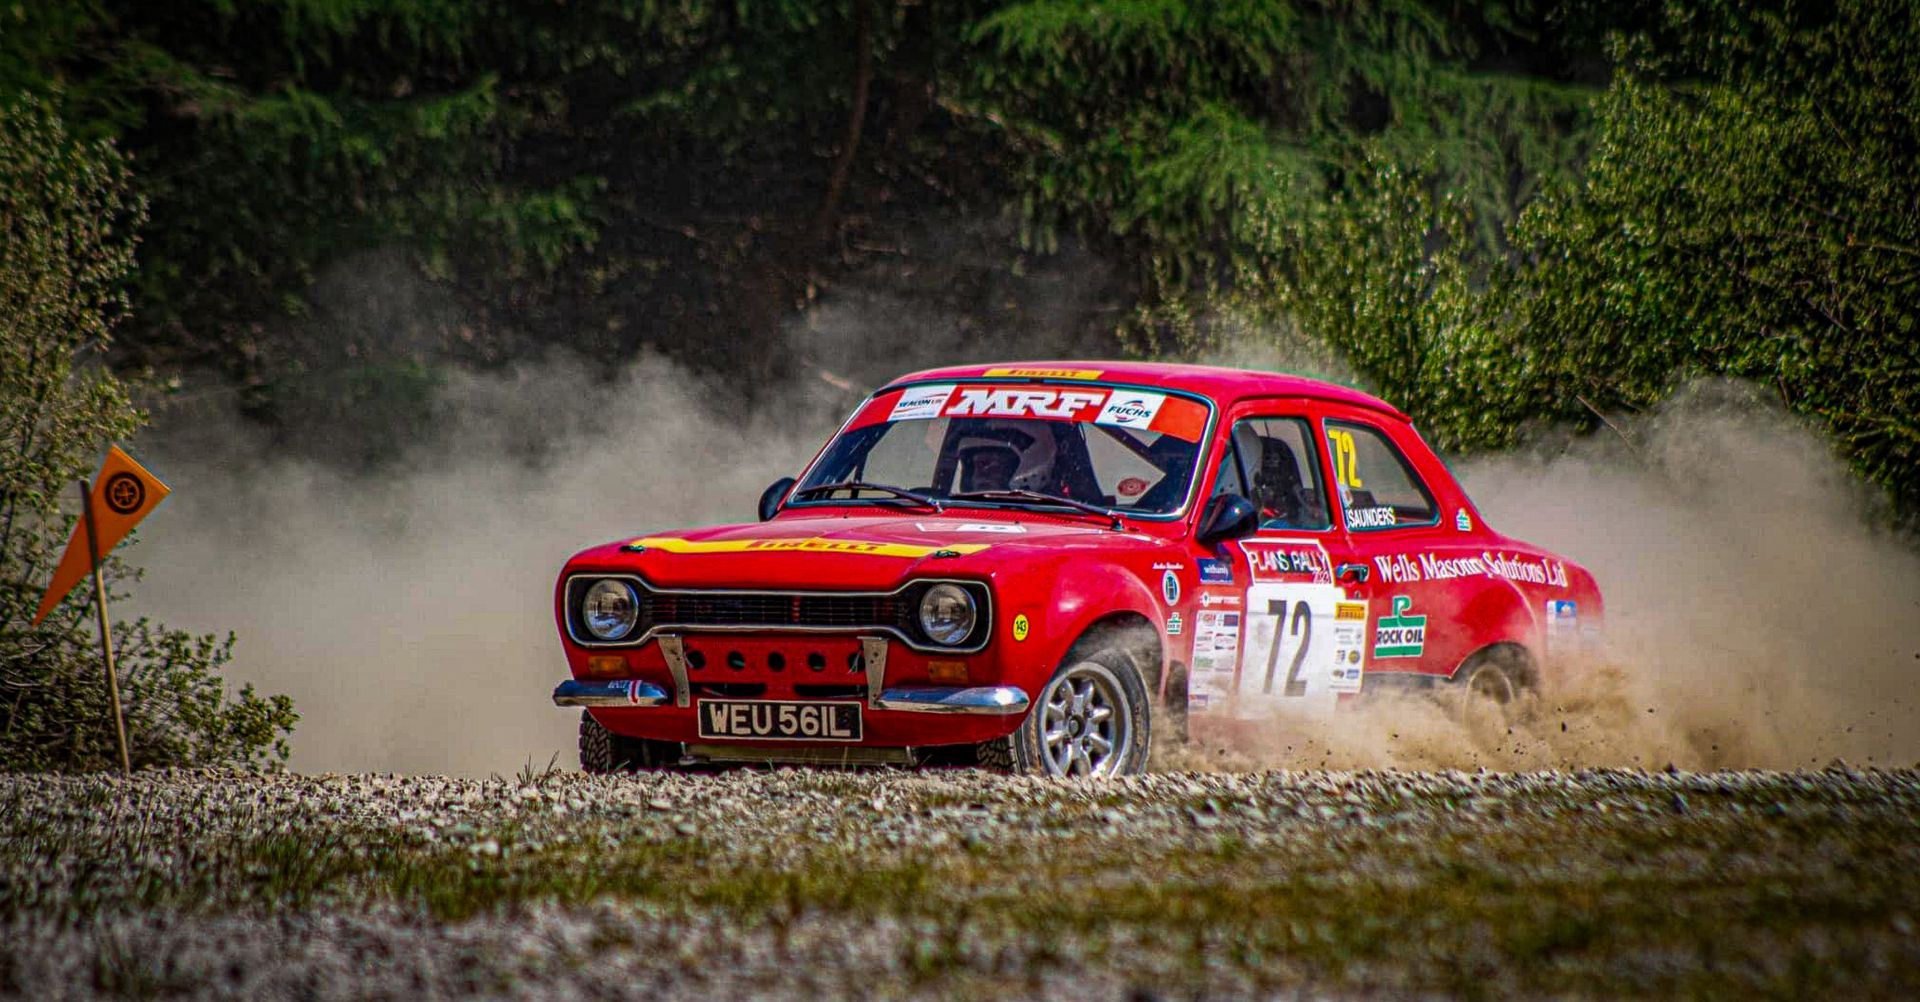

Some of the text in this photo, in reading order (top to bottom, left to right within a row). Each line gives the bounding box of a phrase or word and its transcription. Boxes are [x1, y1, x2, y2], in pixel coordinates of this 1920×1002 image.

[945, 389, 1106, 418] MRF
[1107, 405, 1152, 418] FUCHS
[1328, 429, 1363, 488] 72
[1347, 506, 1396, 528] SAUNDERS
[1289, 550, 1328, 572] RALLY
[1374, 553, 1421, 583] Wells
[1482, 551, 1547, 585] Solutions
[1263, 599, 1312, 697] 72
[1377, 628, 1424, 645] ROCK OIL
[709, 703, 851, 737] WEU 561L
